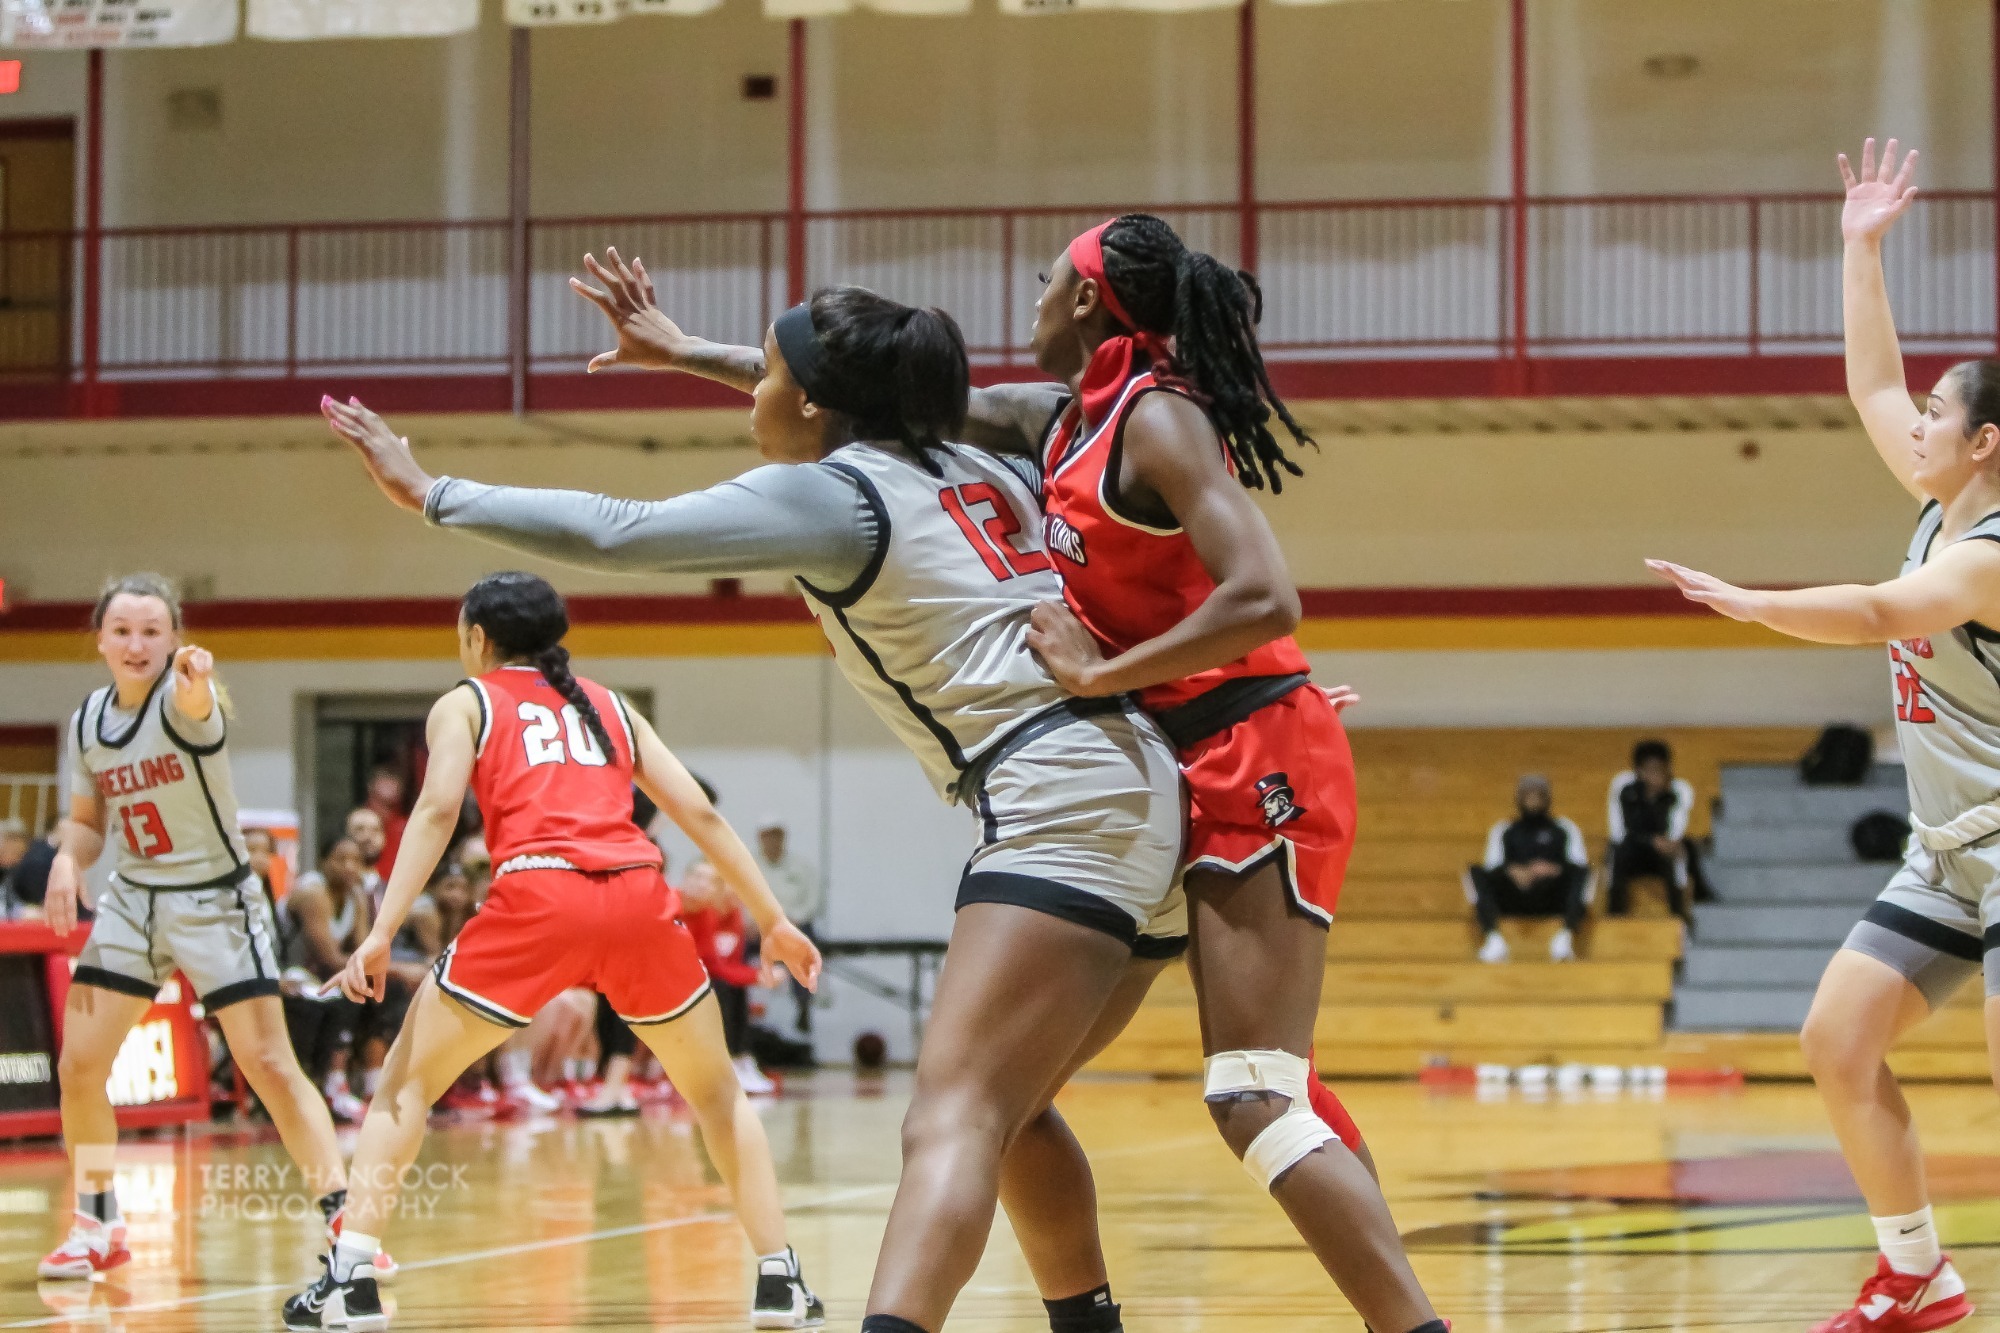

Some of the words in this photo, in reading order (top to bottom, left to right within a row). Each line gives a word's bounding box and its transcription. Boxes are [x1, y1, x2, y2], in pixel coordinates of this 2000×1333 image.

[938, 481, 1051, 582] 12
[518, 701, 607, 767] 20
[96, 753, 184, 799] HEELING
[119, 801, 173, 859] 13
